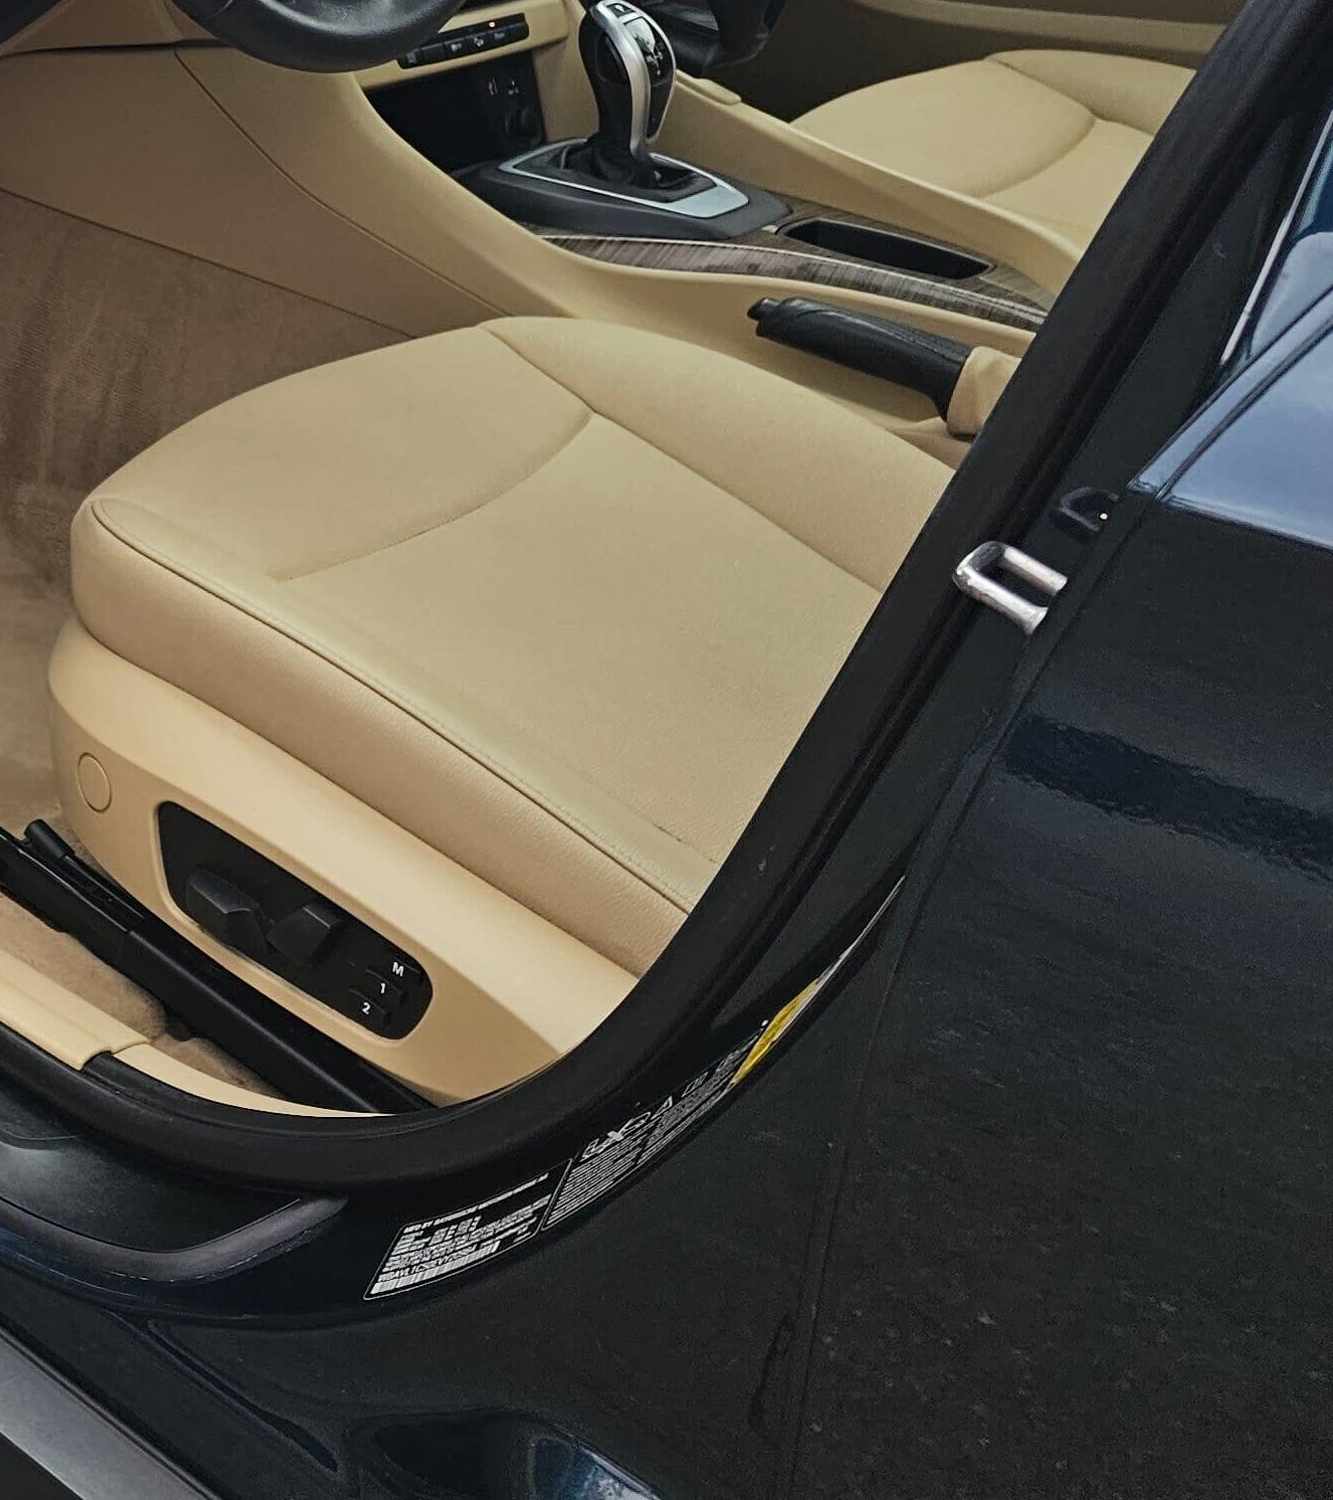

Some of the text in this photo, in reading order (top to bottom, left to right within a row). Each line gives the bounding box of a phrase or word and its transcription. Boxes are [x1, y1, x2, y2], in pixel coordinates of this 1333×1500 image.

[392, 961, 405, 977] M
[380, 982, 386, 994] 1
[362, 1001, 371, 1015] 2
